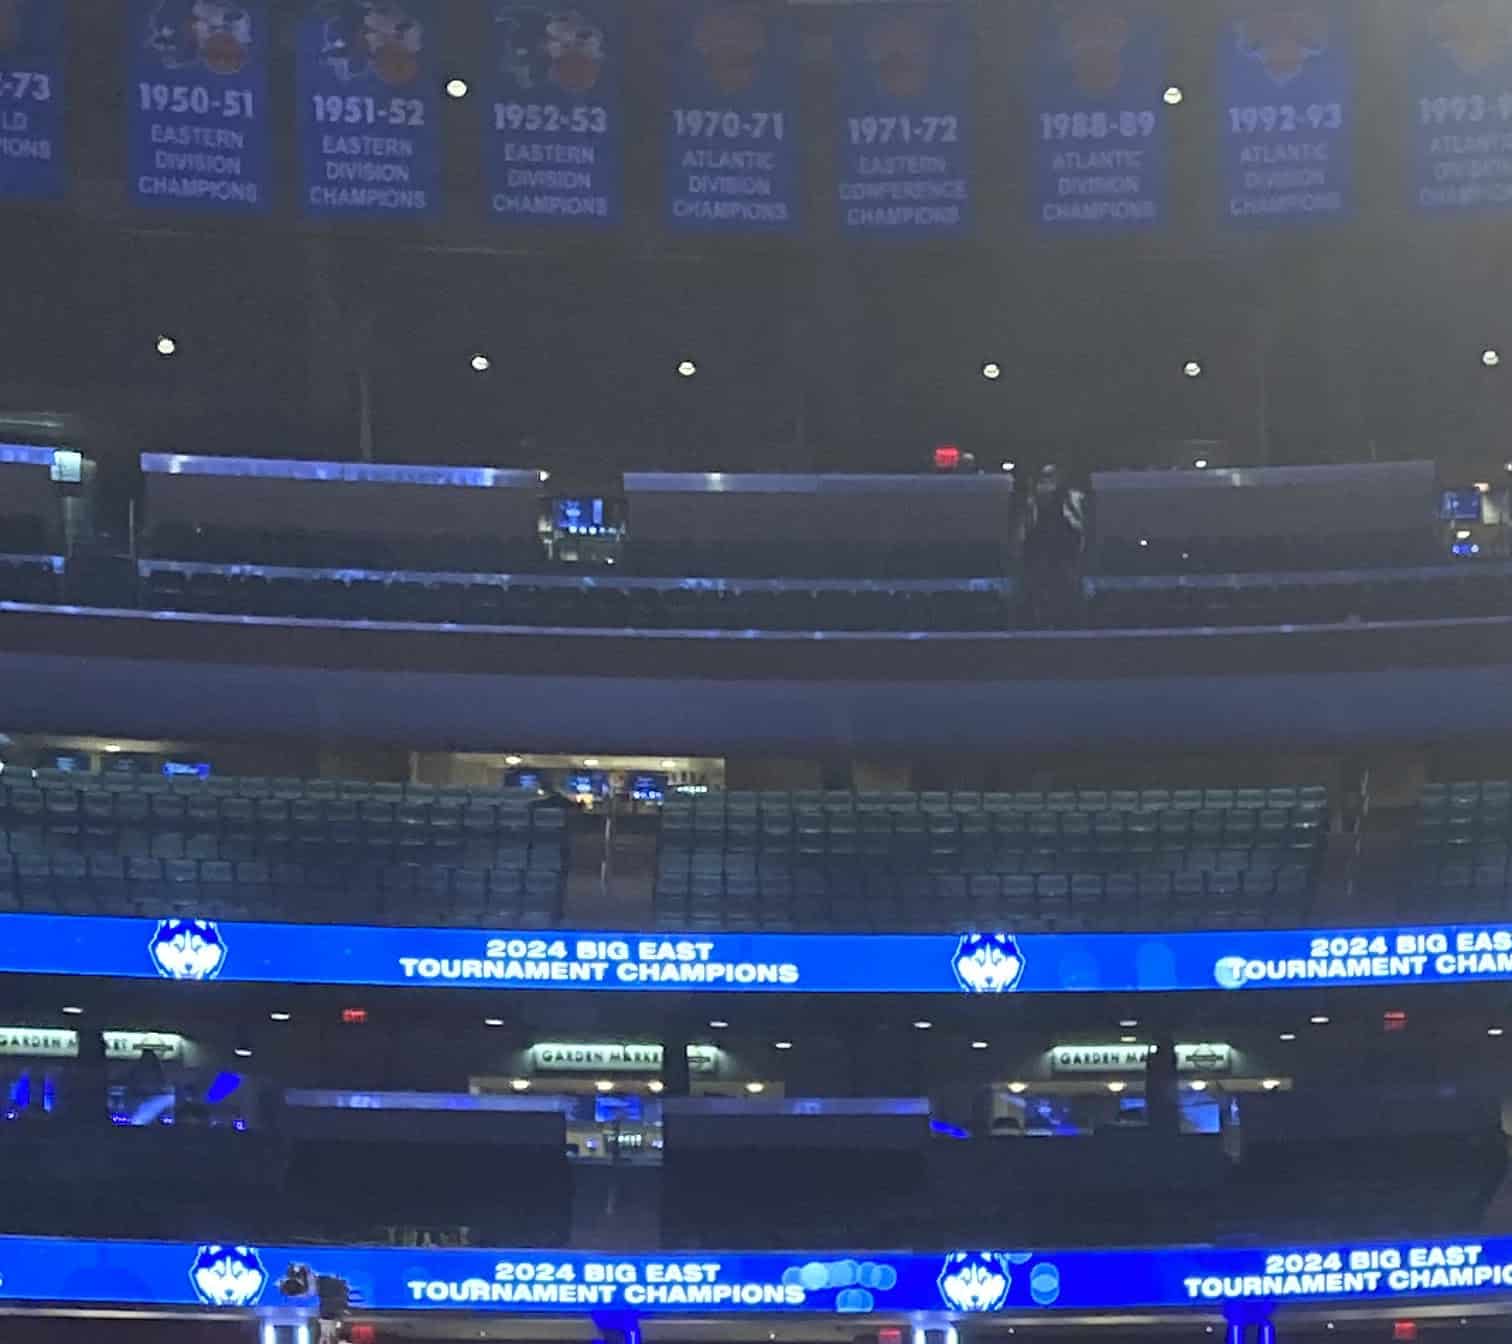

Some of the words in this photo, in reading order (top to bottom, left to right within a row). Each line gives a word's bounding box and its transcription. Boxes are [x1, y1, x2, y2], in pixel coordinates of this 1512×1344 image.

[138, 81, 255, 119] 1950-51
[311, 94, 425, 127] 1951-52
[493, 102, 607, 134] 1952-53
[672, 108, 784, 140] 1970-71
[847, 114, 959, 145] 1971-72
[1228, 103, 1343, 133] 1992-93
[150, 124, 244, 149] EASTERN
[322, 135, 413, 158] EASTERN
[504, 144, 595, 165] EASTERN
[326, 161, 409, 182] DIVISION
[138, 176, 258, 204] CHAMPIONS
[486, 939, 567, 960] 2024
[577, 940, 630, 960] BIG
[638, 941, 714, 962] EAST
[1310, 936, 1388, 958] 2024
[1397, 932, 1448, 954] BIG
[400, 958, 608, 982] TOURNAMENT
[616, 961, 799, 984] CHAMPIONS
[1228, 955, 1432, 981] TOURNAMENT
[542, 1049, 601, 1064] GARDEN
[1059, 1052, 1118, 1067] GARDEN
[495, 1262, 575, 1283] 2024
[583, 1263, 637, 1283] BIG
[645, 1263, 720, 1284] EAST
[1266, 1253, 1341, 1275] 2024
[1350, 1249, 1401, 1271] BIG
[1409, 1246, 1482, 1268] EAST
[408, 1280, 616, 1304] TOURNAMENT
[624, 1283, 804, 1304] CHAMPIONS
[1185, 1271, 1384, 1298] TOURNAMENT
